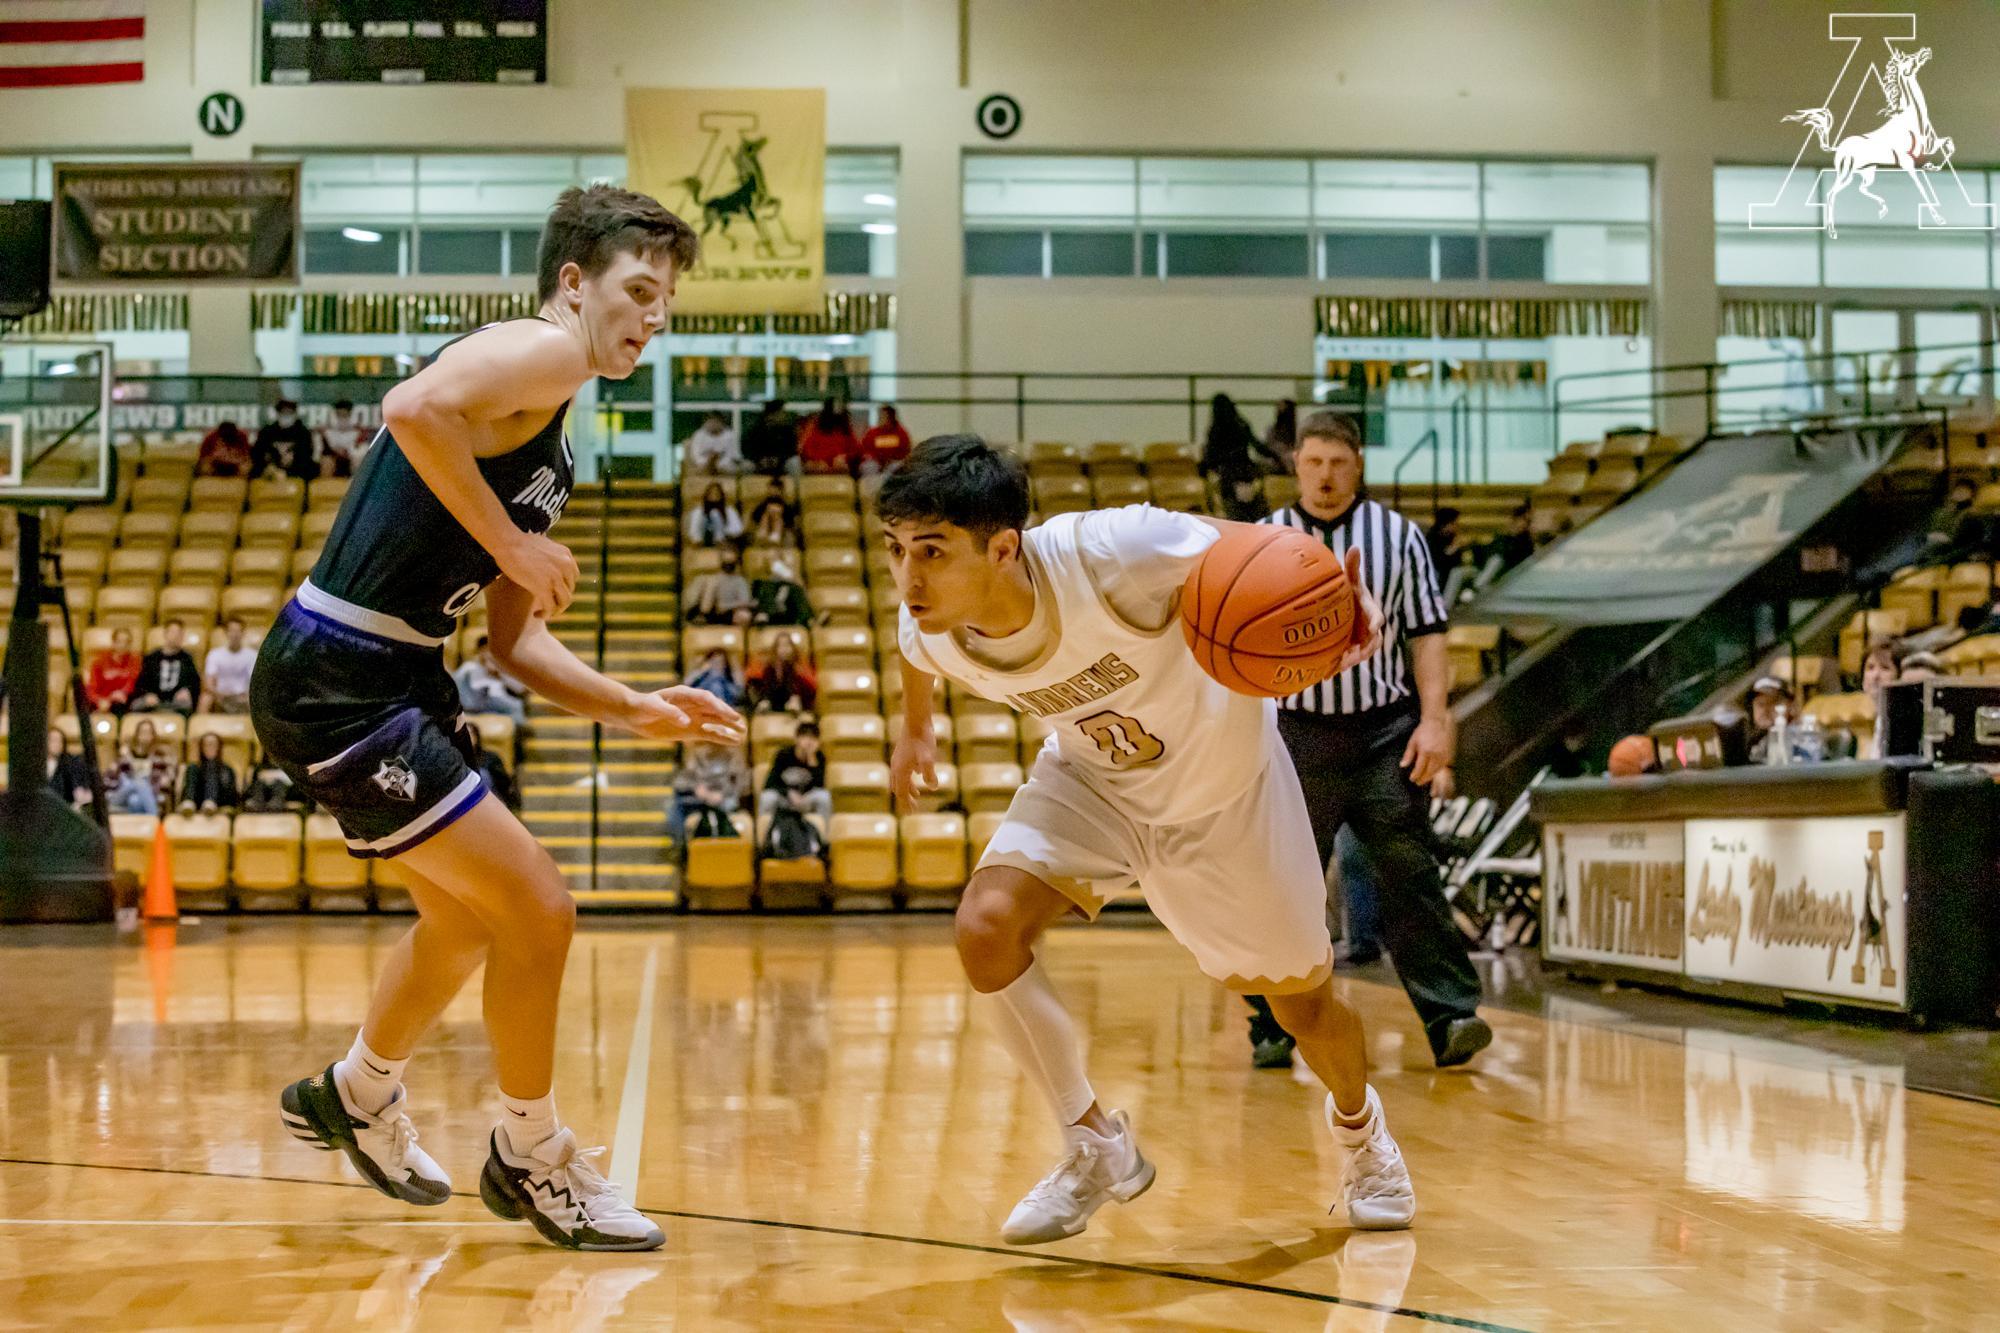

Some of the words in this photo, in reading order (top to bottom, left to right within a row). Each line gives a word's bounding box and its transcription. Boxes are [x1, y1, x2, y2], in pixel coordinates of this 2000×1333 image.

[207, 97, 236, 131] N
[983, 99, 1016, 134] O
[93, 207, 256, 235] STUDENT
[100, 243, 251, 272] SECTION
